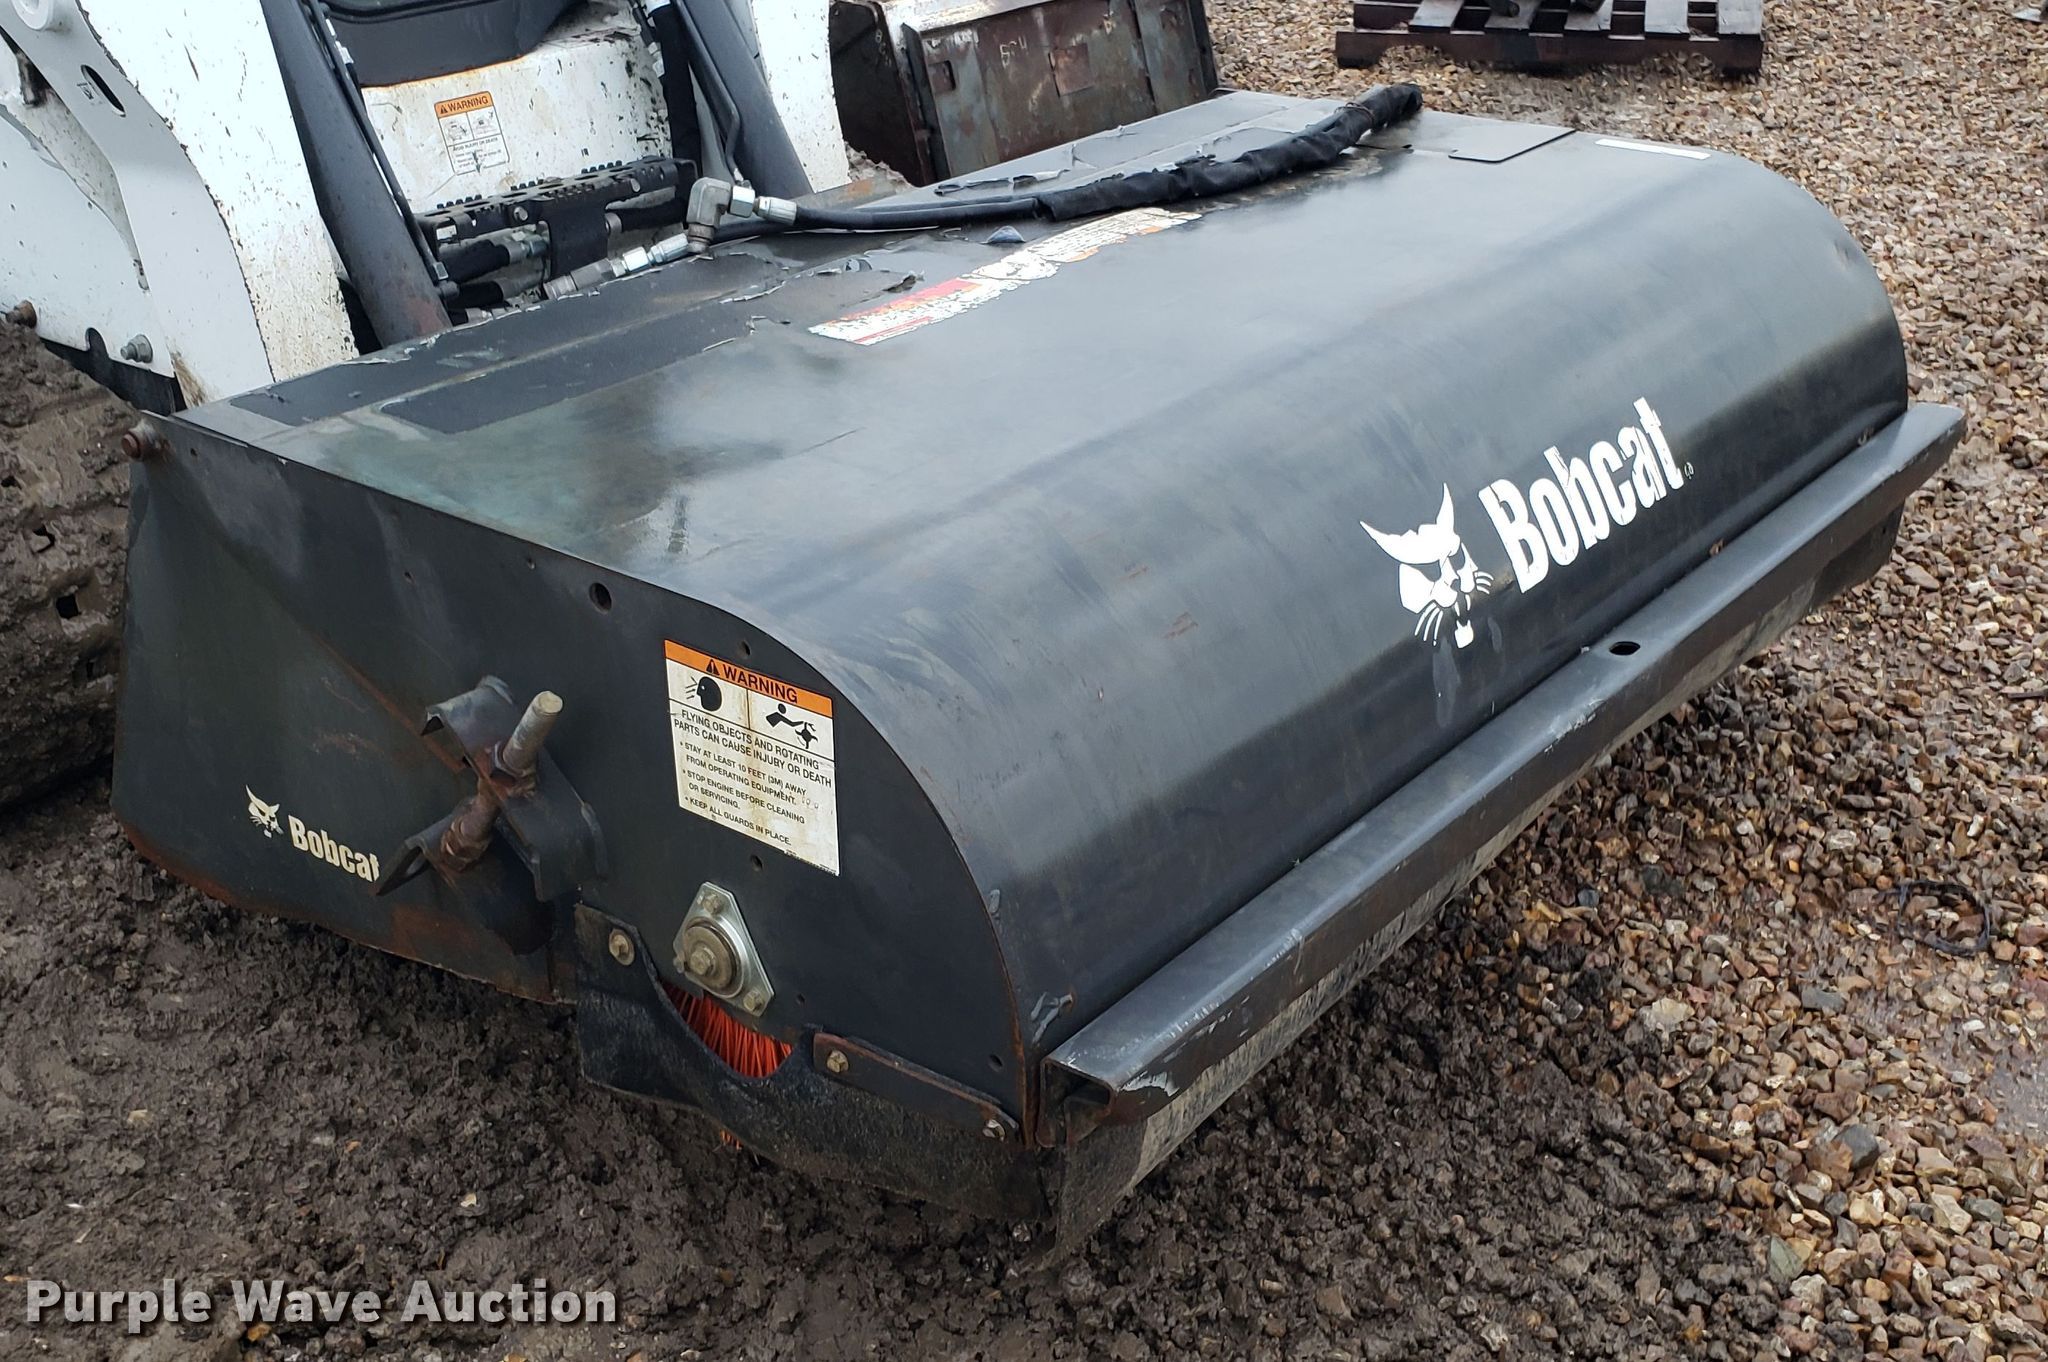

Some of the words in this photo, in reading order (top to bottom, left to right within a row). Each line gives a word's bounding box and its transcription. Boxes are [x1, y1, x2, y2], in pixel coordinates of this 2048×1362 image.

[447, 95, 489, 112] WARNING
[1478, 396, 1684, 594] Bobcat
[723, 664, 798, 704] WARNING
[674, 719, 700, 737] PARTS
[702, 729, 720, 744] CAN
[722, 737, 752, 757] CAUSE
[753, 749, 785, 770] INJURY
[787, 763, 801, 776] OR
[802, 768, 832, 788] DEATH
[681, 709, 710, 728] FLYING
[712, 721, 752, 744] OBJECTS
[755, 737, 773, 752] AND
[775, 745, 819, 770] ROTATING
[685, 742, 702, 755] STAY
[703, 750, 712, 759] AT
[713, 753, 736, 768] LEAST
[737, 763, 747, 772] 10
[748, 767, 766, 780] FEET
[767, 775, 784, 789] (3M)
[785, 782, 807, 796] AWAY
[686, 754, 707, 769] FROM
[708, 764, 750, 786] OPERATING
[751, 781, 797, 805] EQUIPMENT.
[688, 782, 699, 792] OR
[700, 787, 741, 809] SERVICING.
[687, 770, 705, 782] STOP
[707, 777, 734, 795] ENGINE
[735, 790, 765, 808] BEFORE
[766, 802, 805, 824] CLEANING
[690, 797, 708, 809] KEEP
[709, 806, 723, 817] ALL
[723, 811, 755, 830] GUARDS
[755, 825, 764, 834] IN
[765, 828, 792, 846] PLACE.
[288, 814, 380, 882] Bobcat
